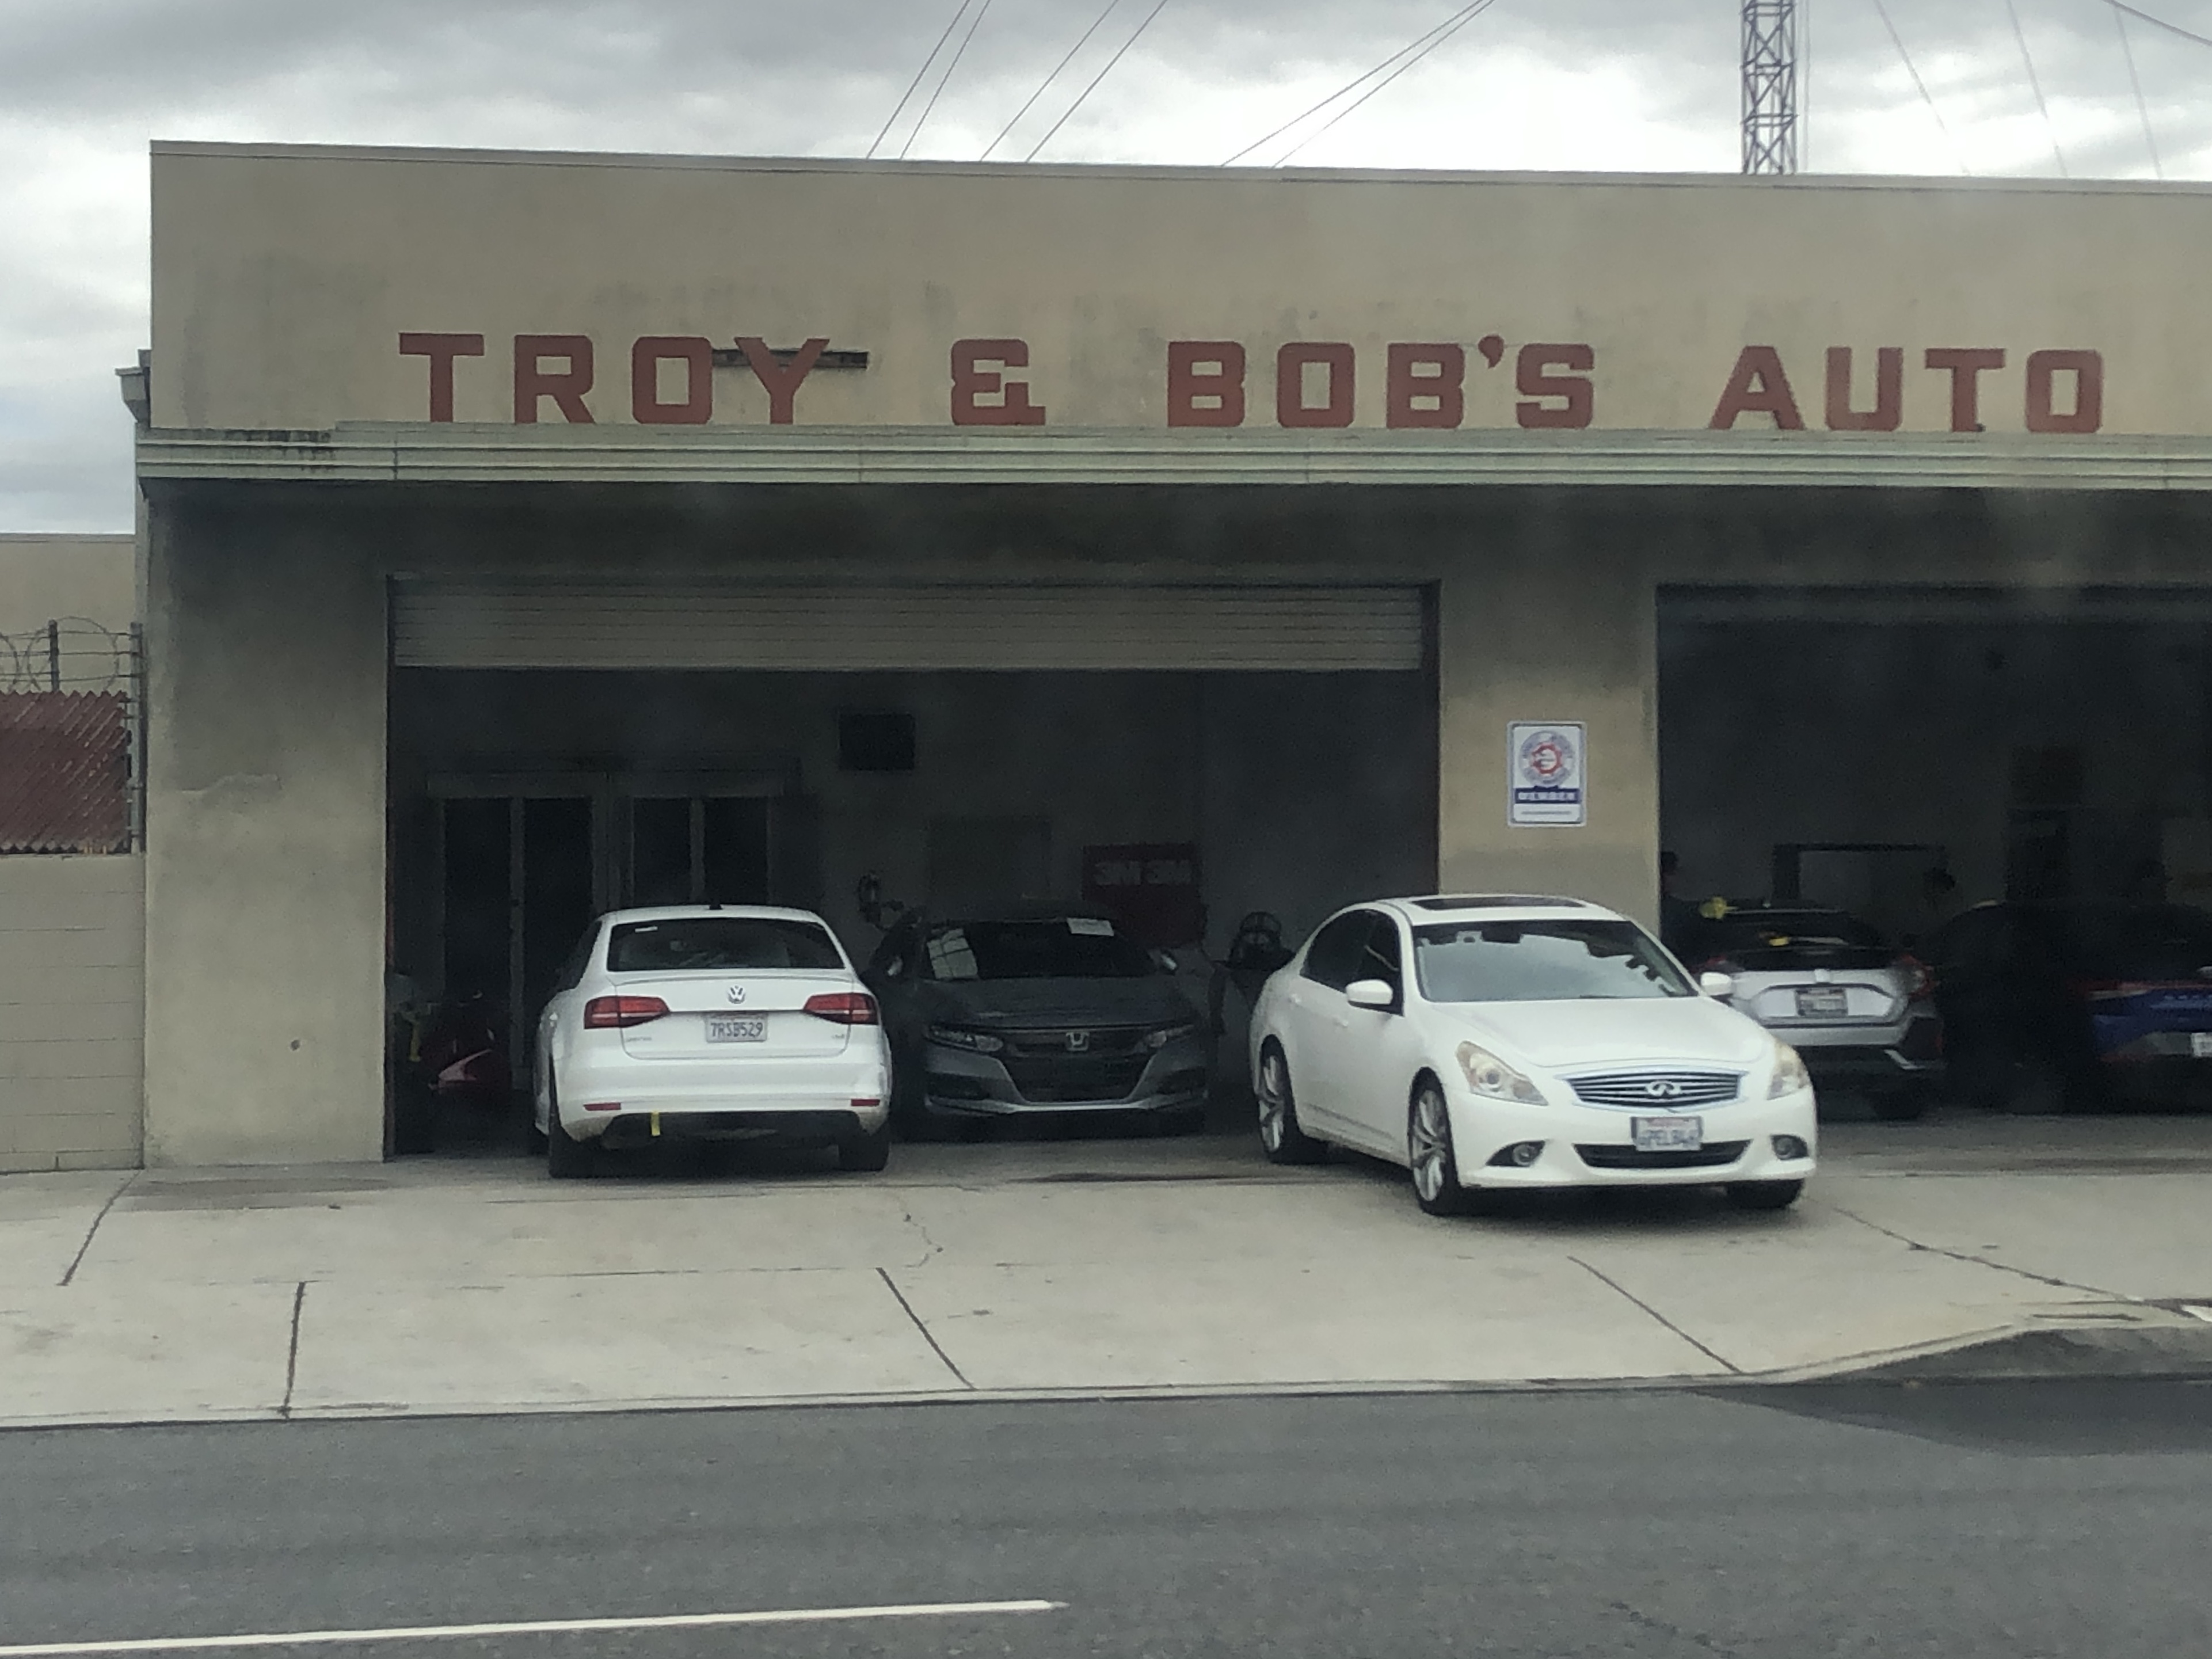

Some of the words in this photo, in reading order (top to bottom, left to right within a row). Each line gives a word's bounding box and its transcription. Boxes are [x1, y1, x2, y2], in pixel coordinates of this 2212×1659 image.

[399, 332, 830, 424] TROY
[951, 338, 1046, 427] &
[1167, 334, 1594, 429] BOB'S
[1708, 346, 2103, 433] AUTO
